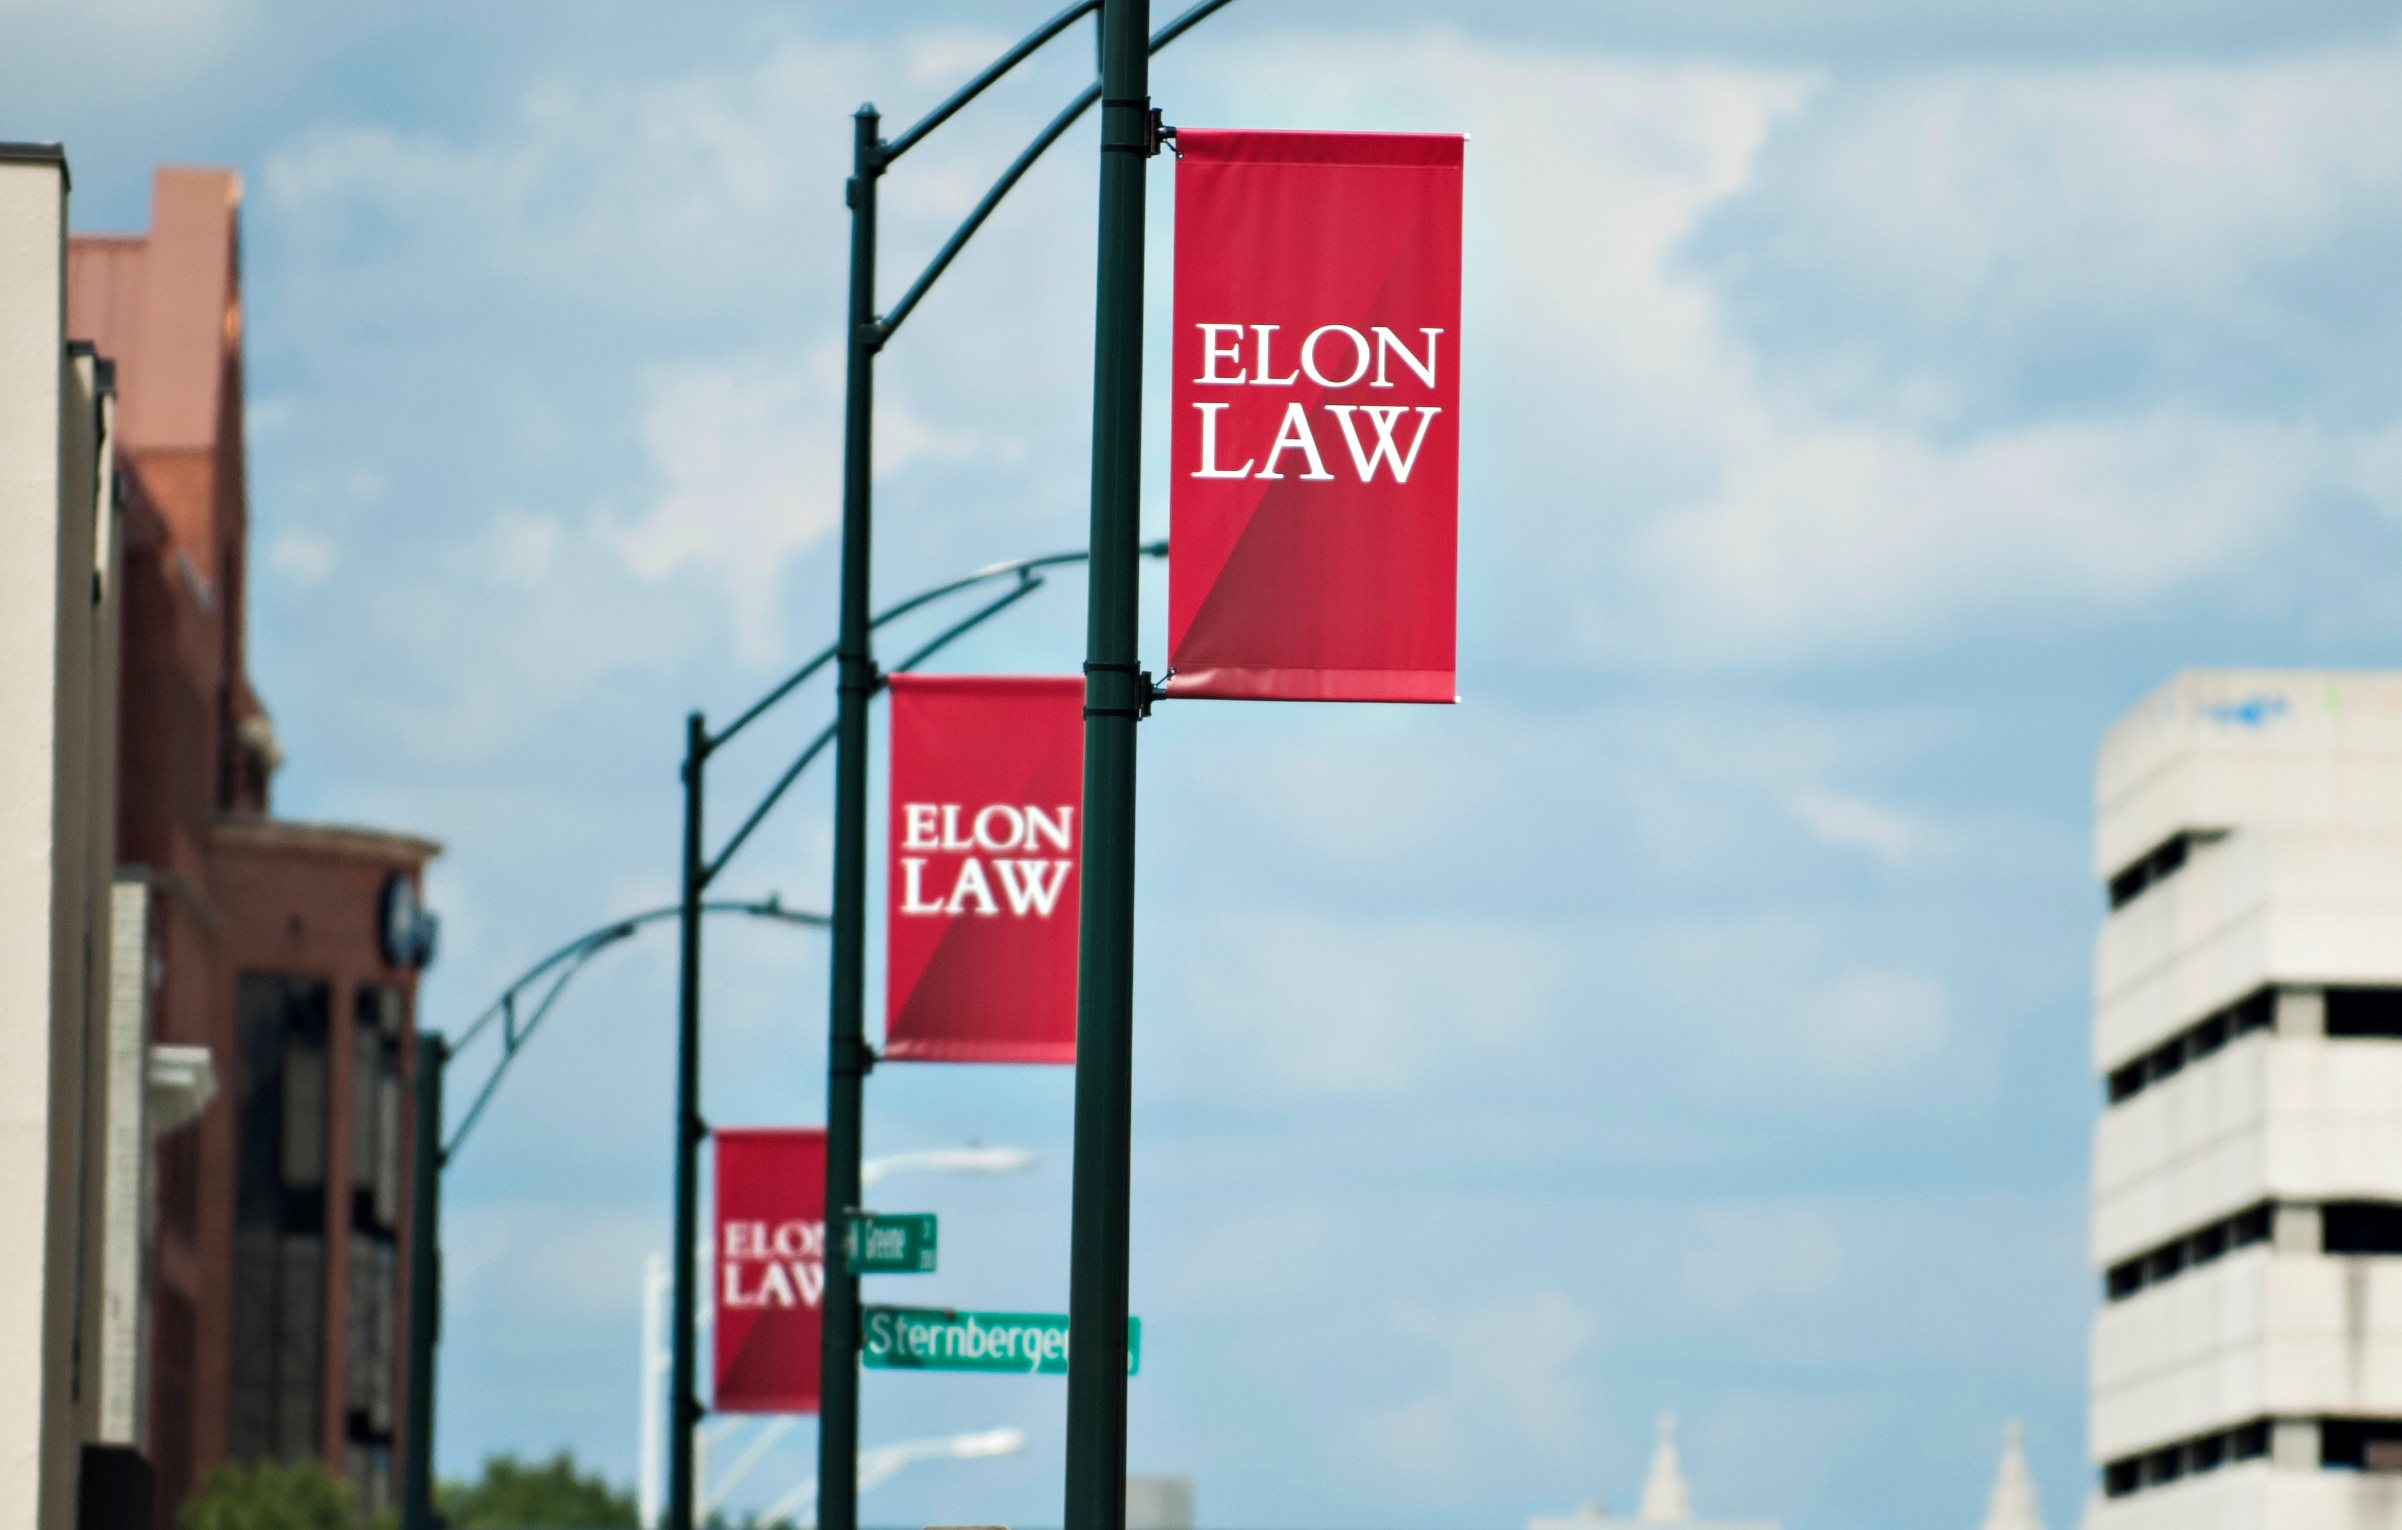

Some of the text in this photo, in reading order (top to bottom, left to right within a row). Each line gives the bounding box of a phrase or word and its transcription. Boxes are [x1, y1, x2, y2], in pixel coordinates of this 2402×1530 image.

[1193, 323, 1445, 389] ELON
[1191, 402, 1442, 483] LAW
[902, 803, 1074, 851] ELON
[901, 857, 1072, 917] LAW
